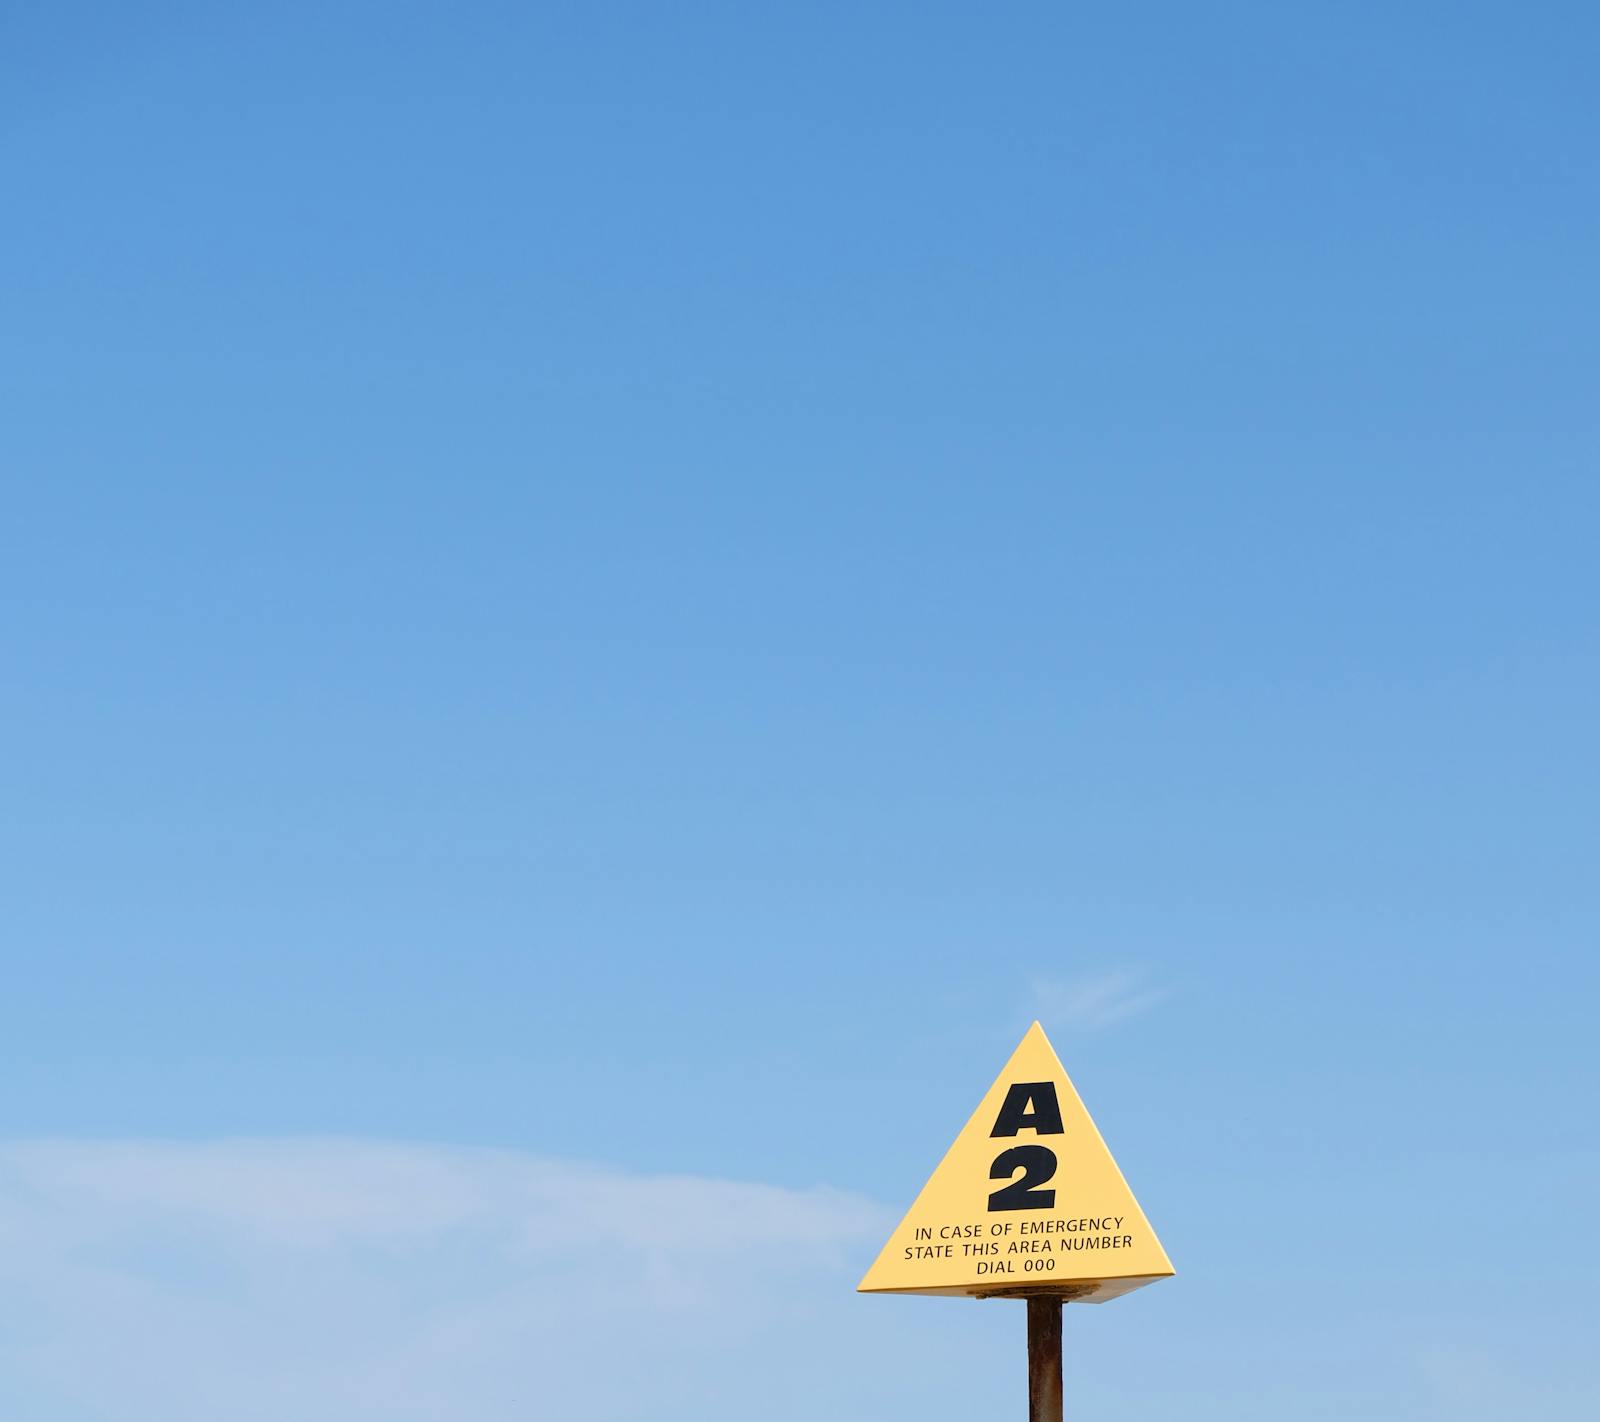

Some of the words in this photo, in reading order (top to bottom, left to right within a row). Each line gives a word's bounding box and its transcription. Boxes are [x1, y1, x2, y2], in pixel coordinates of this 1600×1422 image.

[989, 1081, 1065, 1138] A
[987, 1144, 1058, 1212] 2
[915, 1227, 932, 1241] IN
[939, 1225, 982, 1239] CASE
[990, 1223, 1013, 1236] OF
[1020, 1216, 1125, 1235] EMERGENCY
[904, 1246, 953, 1260] STATE
[962, 1242, 999, 1257] THIS
[1007, 1239, 1052, 1254] AREA
[1060, 1235, 1133, 1251] NUMBER
[976, 1260, 1015, 1275] DIAL
[1024, 1258, 1056, 1272] 000
